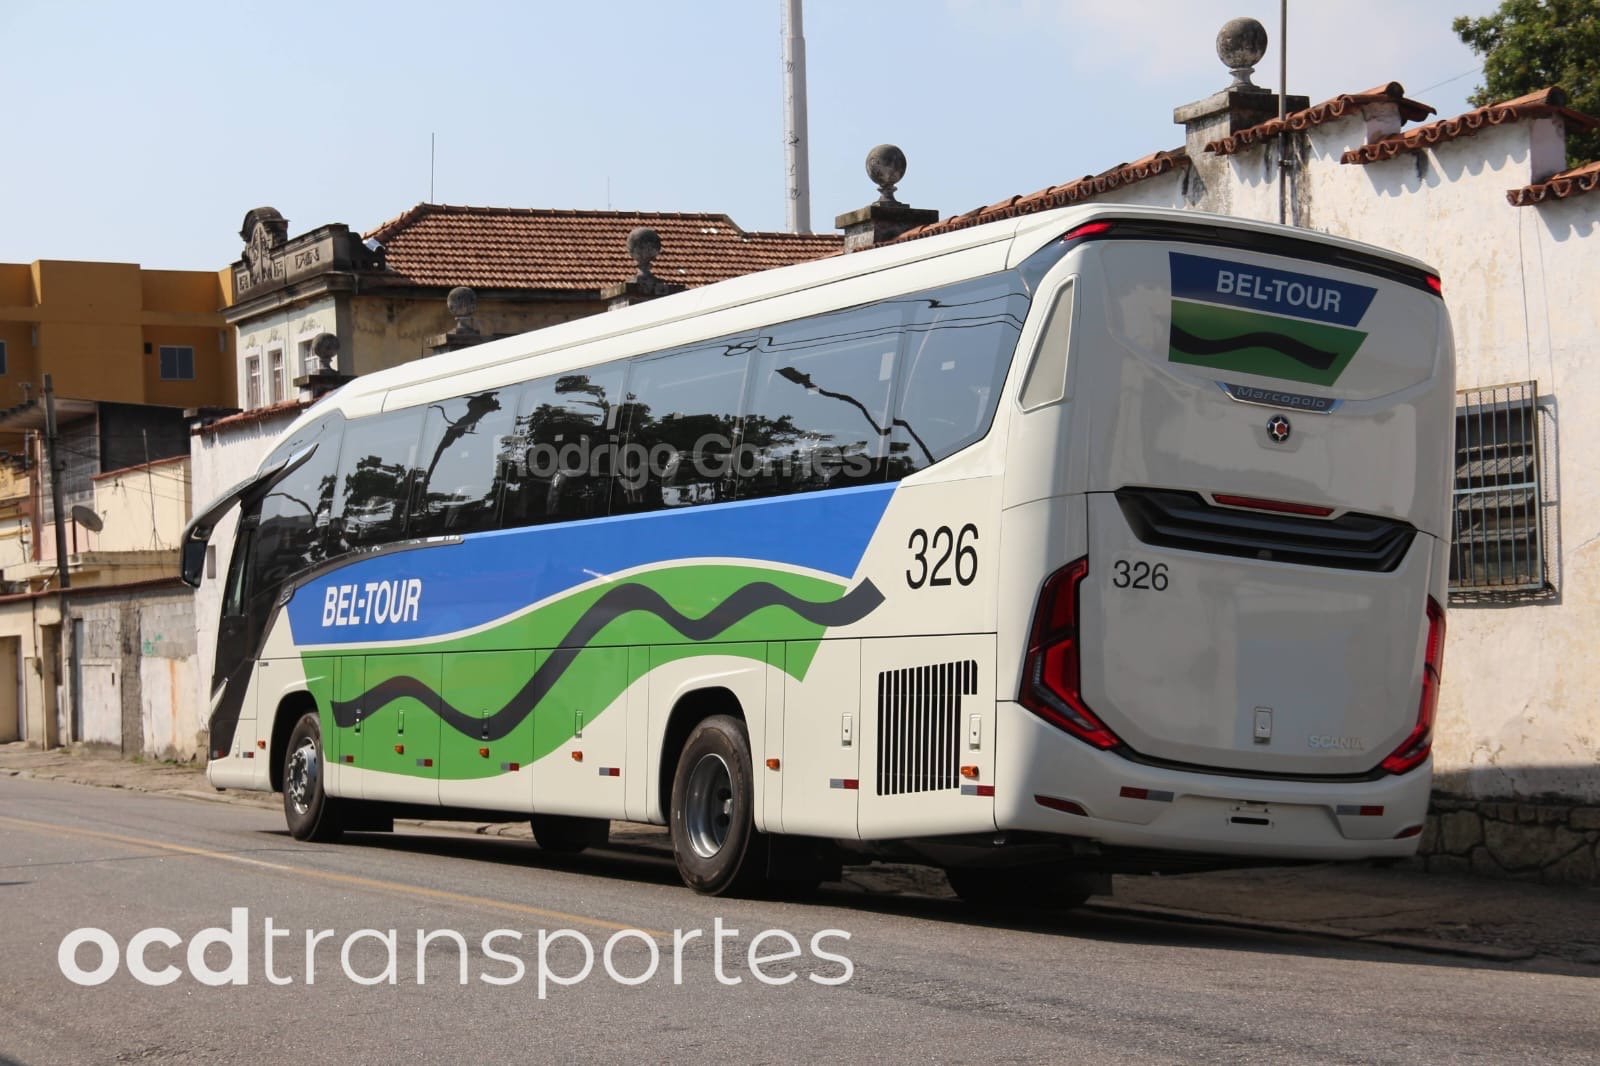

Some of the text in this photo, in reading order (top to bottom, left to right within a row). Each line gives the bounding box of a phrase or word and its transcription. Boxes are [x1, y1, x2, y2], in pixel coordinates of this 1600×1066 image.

[1216, 270, 1341, 313] BEL-TOUR
[1236, 387, 1326, 408] Marcopolo
[906, 523, 979, 590] 326
[1112, 559, 1169, 591] 326
[322, 578, 422, 627] BEL-TOUR
[1308, 734, 1364, 751] SCANIA
